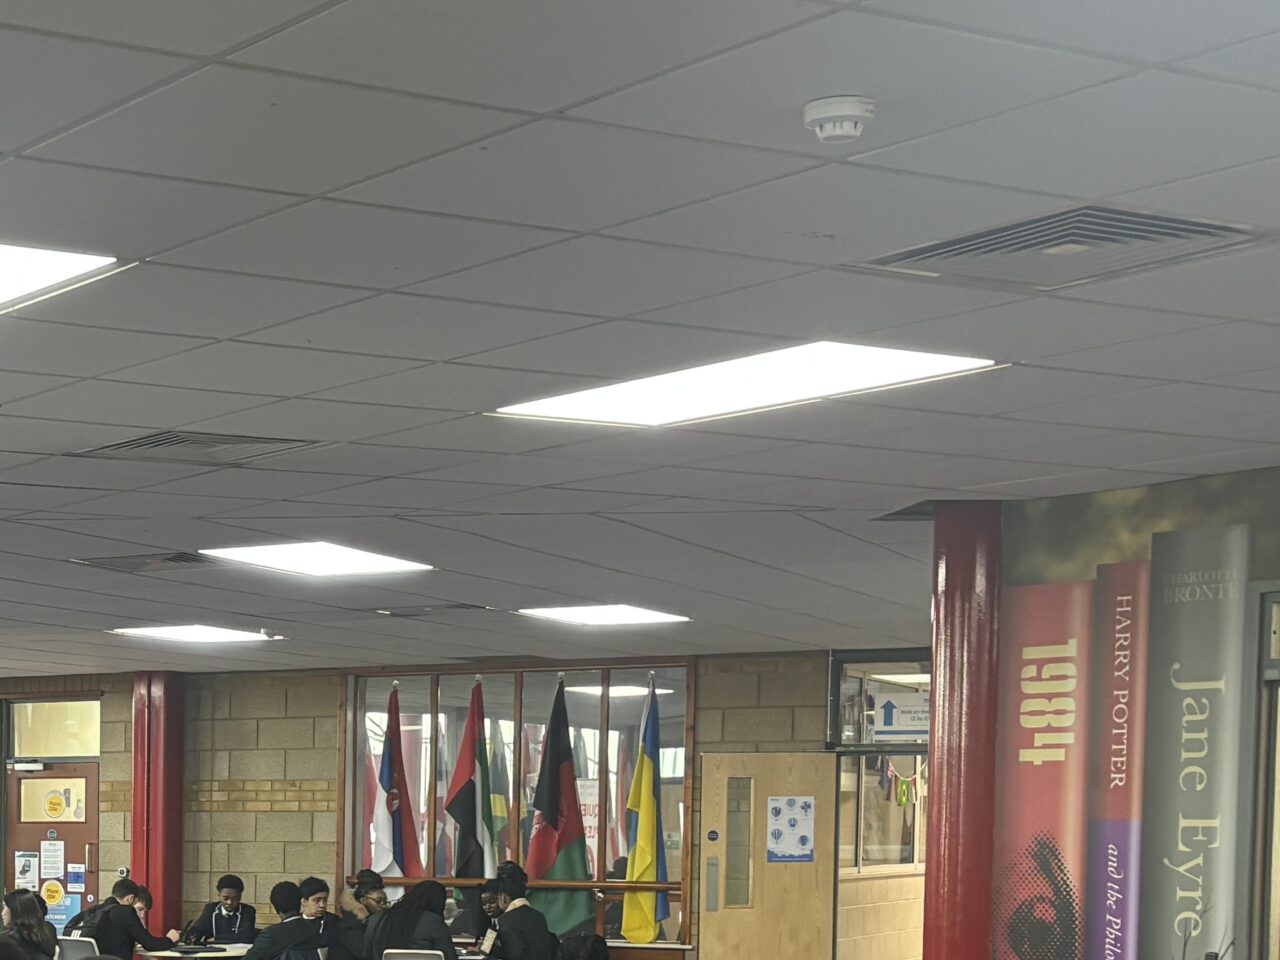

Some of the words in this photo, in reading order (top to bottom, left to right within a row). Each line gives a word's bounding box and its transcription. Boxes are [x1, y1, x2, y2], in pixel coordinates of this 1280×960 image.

[1113, 595, 1132, 681] HARRY
[1018, 638, 1077, 765] 1984
[1110, 689, 1129, 789] POTTER
[1170, 661, 1226, 792] Jane
[1106, 882, 1123, 910] the
[1107, 844, 1124, 879] and
[1162, 812, 1221, 937] Eyre
